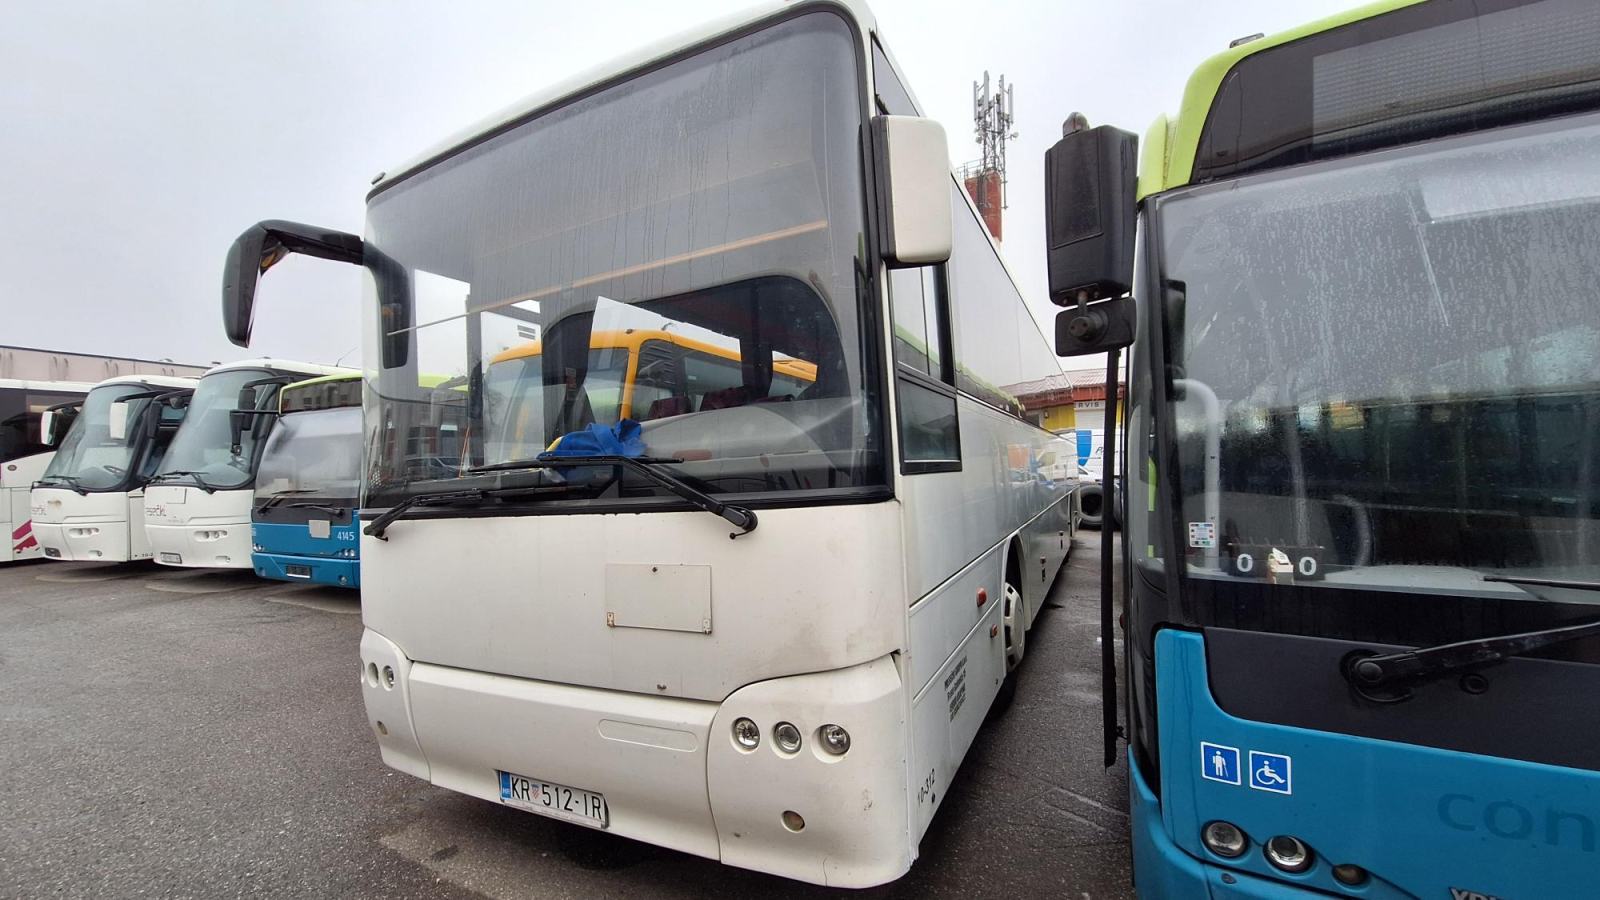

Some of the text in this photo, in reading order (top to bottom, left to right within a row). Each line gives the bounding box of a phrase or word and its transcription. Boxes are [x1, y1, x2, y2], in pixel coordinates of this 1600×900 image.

[337, 531, 355, 541] 4145
[511, 776, 602, 820] KR 512-IR
